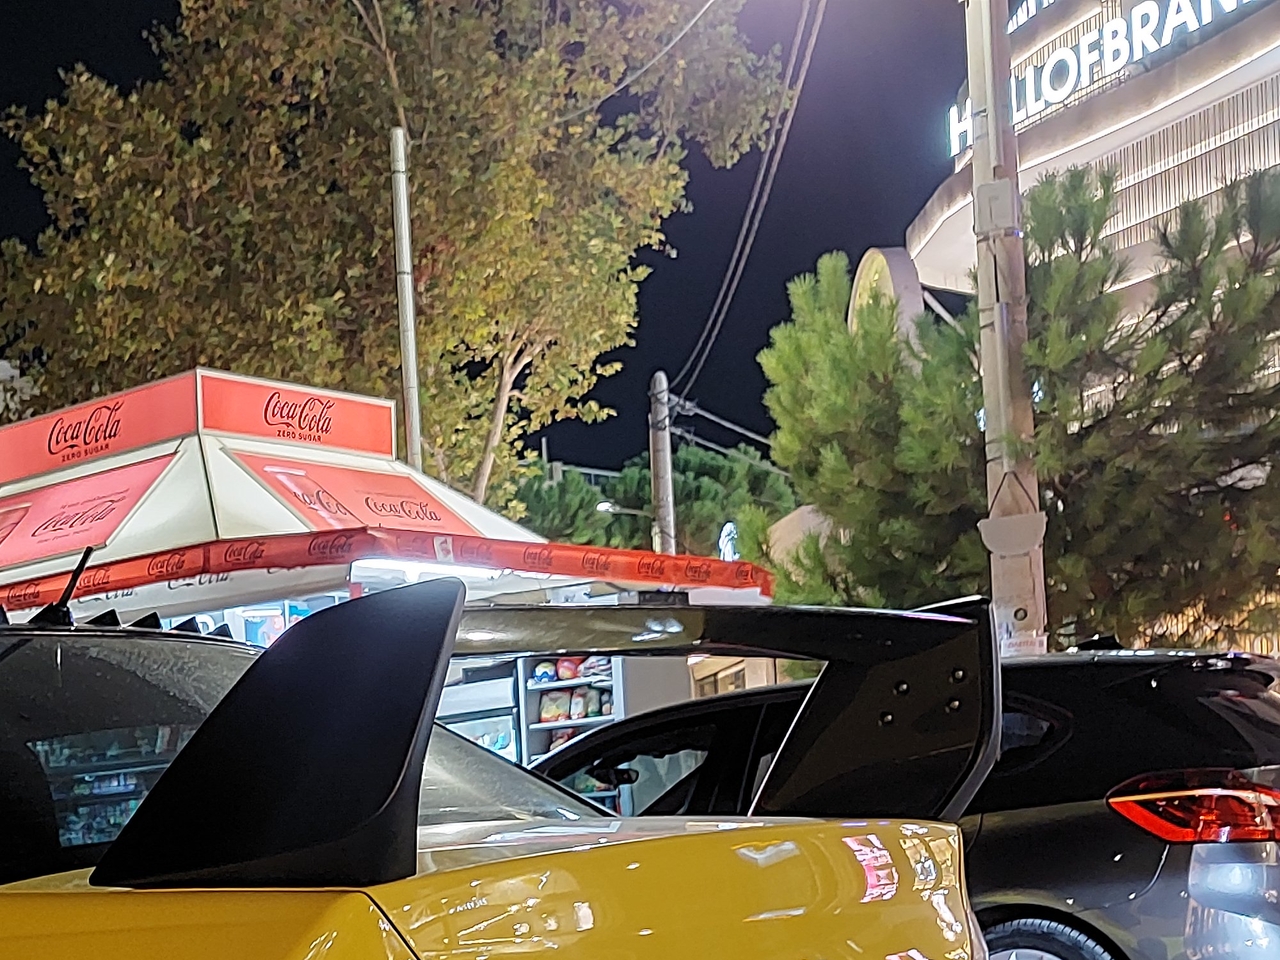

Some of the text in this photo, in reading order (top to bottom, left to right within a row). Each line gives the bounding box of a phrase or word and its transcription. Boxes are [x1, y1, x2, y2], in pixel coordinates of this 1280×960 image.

[47, 400, 125, 455] Coca-Cola
[263, 391, 335, 435] Coca-Cola
[277, 430, 322, 443] ZERO SUGAR
[61, 443, 110, 463] ZERO SUGAR
